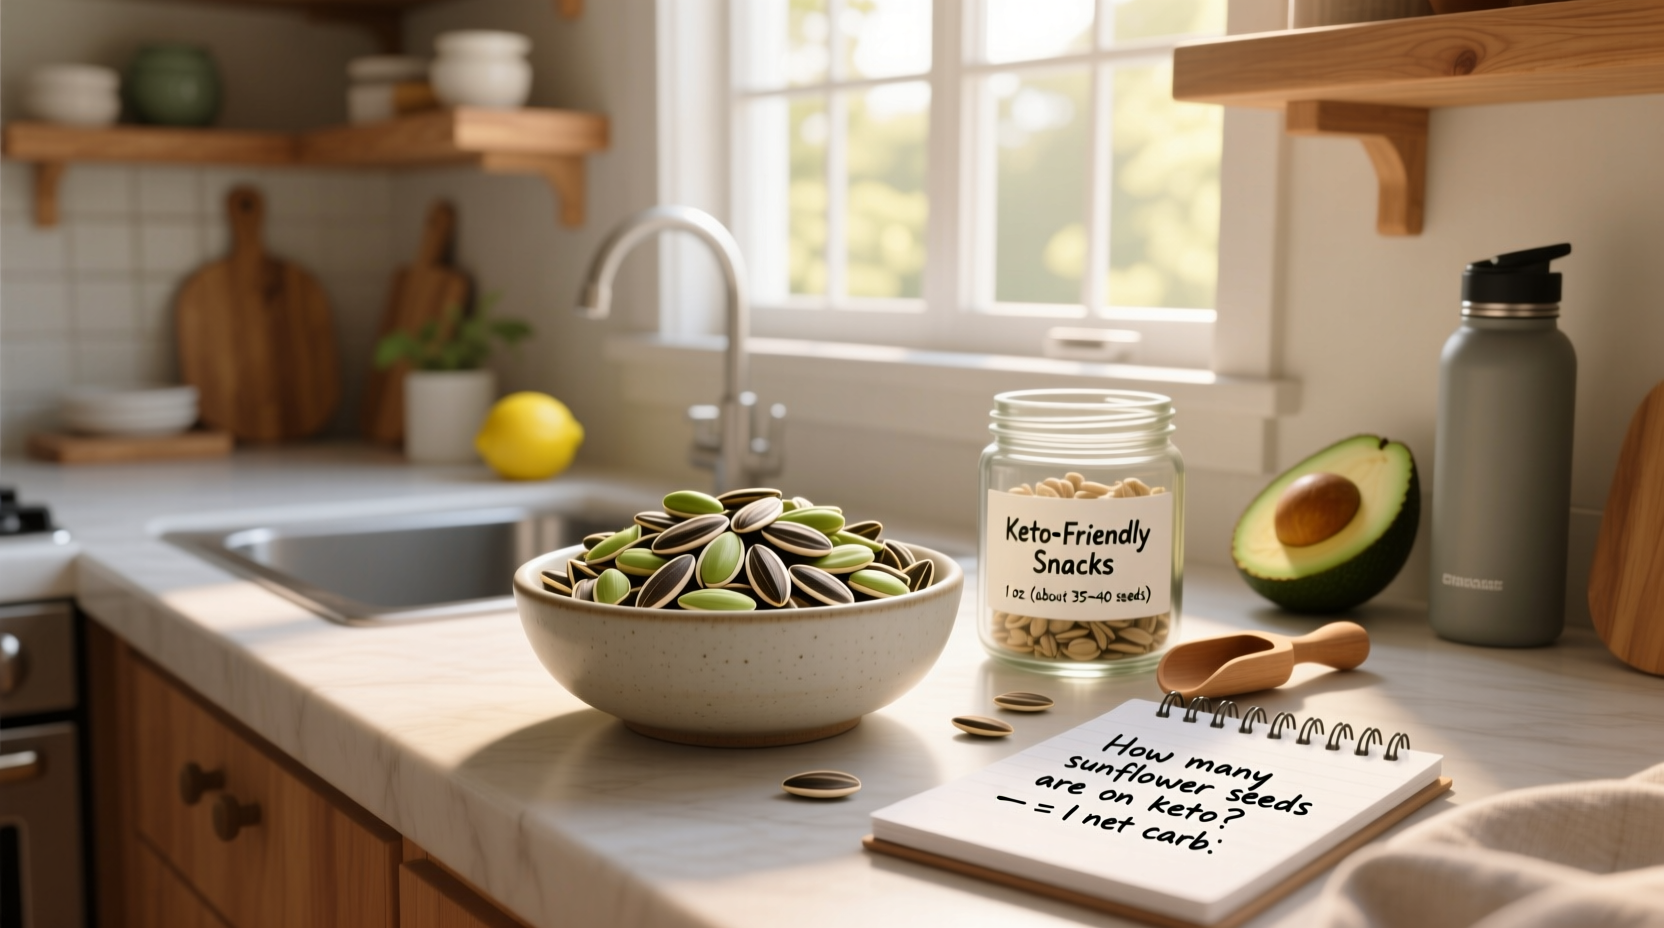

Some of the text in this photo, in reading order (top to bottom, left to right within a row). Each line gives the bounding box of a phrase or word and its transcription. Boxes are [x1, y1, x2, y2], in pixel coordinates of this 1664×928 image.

[1006, 516, 1151, 553] Keto-Friendly
[1032, 549, 1114, 576] Snacks
[1012, 588, 1025, 600] oz
[1030, 585, 1067, 603] (about
[1101, 733, 1274, 792] How many
[1035, 772, 1246, 830] are on keto?
[1064, 754, 1313, 816] sunflower seeds
[1081, 811, 1136, 834] net
